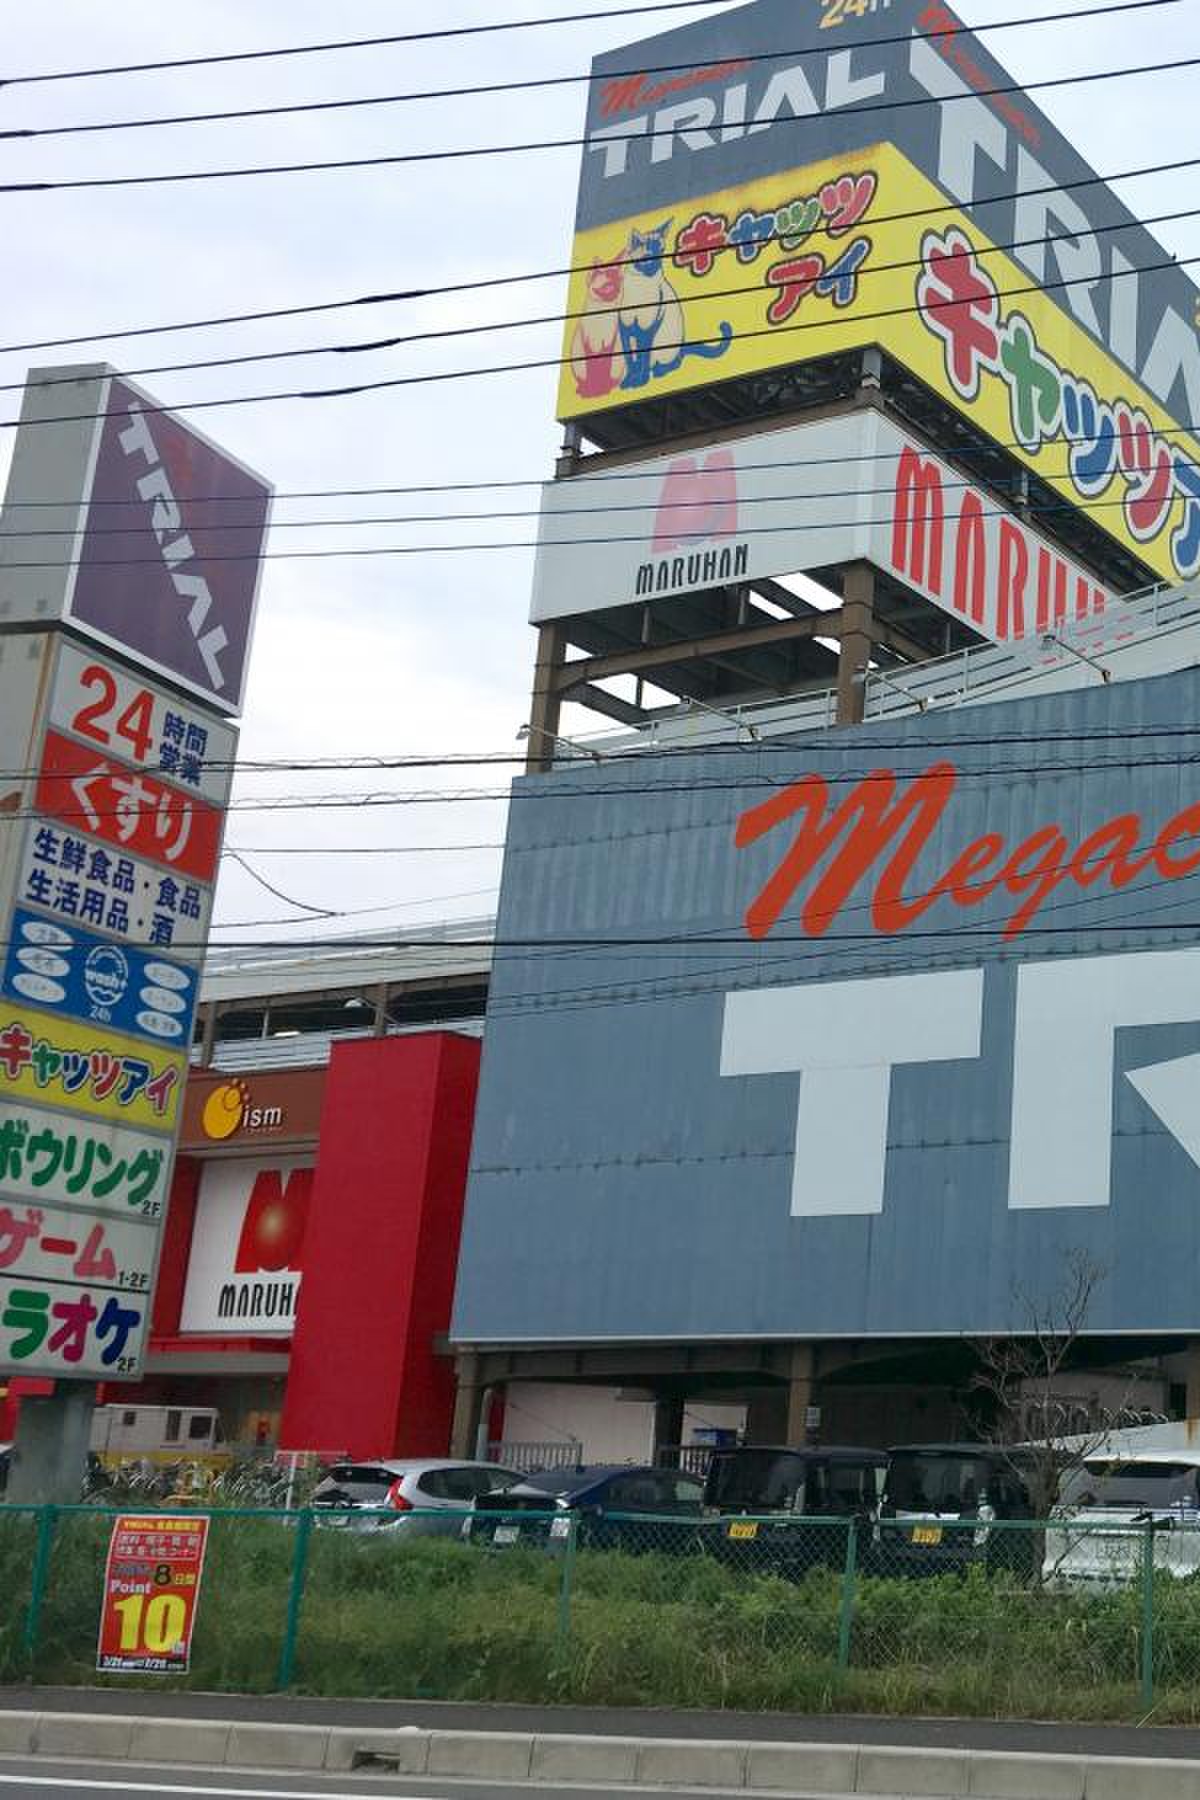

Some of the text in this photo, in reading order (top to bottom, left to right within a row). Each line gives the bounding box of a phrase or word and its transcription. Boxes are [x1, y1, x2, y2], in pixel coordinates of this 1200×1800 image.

[589, 49, 886, 178] TRIAL
[674, 170, 877, 277] キャッツ
[767, 237, 872, 324] アイ
[117, 401, 228, 691] TRIAL
[635, 543, 749, 596] MARUHAN
[72, 665, 155, 762] 24
[162, 711, 208, 757] 時間
[71, 761, 193, 861] くすり
[0, 1023, 178, 1118] キャッツアイ
[243, 1104, 282, 1128] ism
[0, 1119, 164, 1206] ボウリング
[0, 1207, 117, 1281] ゲーム
[141, 1201, 160, 1217] 2F
[217, 1282, 298, 1319] MARUH
[117, 1358, 135, 1374] 2F
[111, 1578, 152, 1595] Point
[113, 1593, 187, 1654] 10
